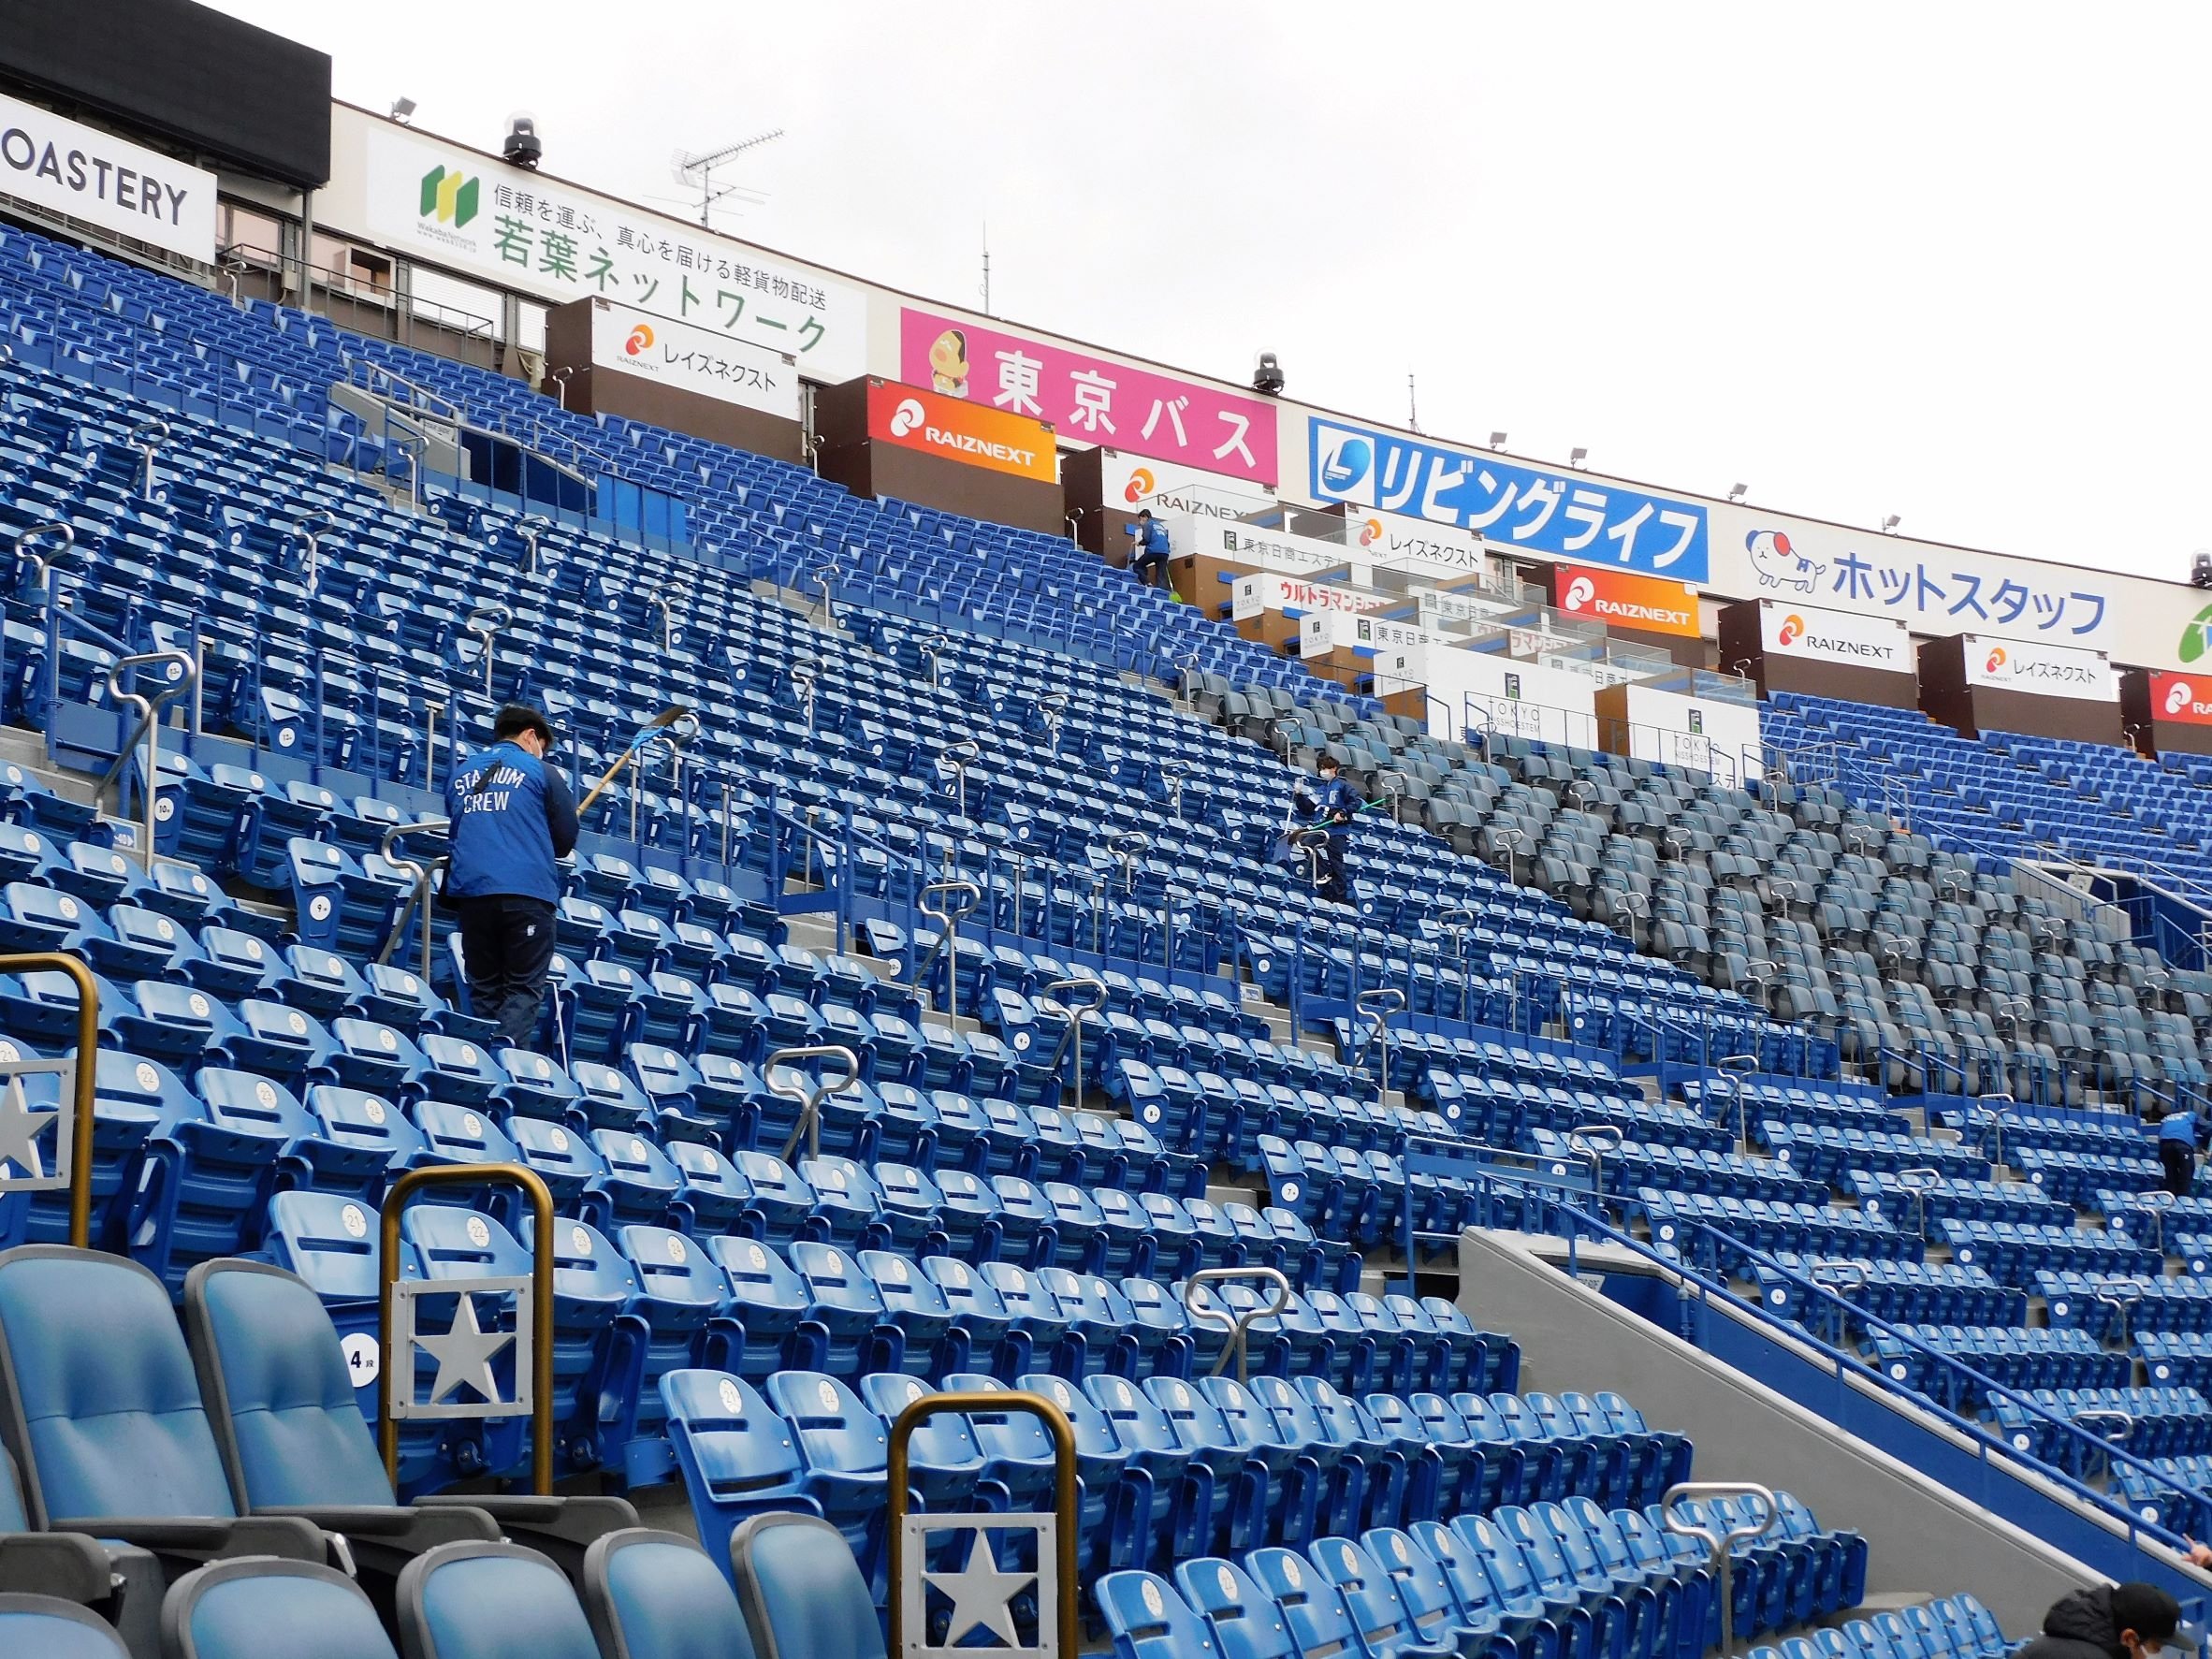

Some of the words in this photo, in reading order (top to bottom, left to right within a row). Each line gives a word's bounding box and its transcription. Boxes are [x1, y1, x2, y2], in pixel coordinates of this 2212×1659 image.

[2, 127, 188, 226] OASTERY
[494, 182, 826, 311] 信頼を運ぶ、真心を届ける軽貨物配送
[493, 212, 826, 354] 若葉ネットワーク
[617, 355, 660, 372] RAIZNEXT
[664, 342, 777, 392] レイズネクスト
[993, 349, 1258, 469] 東京バス
[924, 426, 1036, 467] RAIZNEXT
[1157, 493, 1249, 520] RAIZNEX
[1380, 446, 1700, 570] リビングライフ
[1244, 538, 1343, 569] 東京日商エステ
[1390, 533, 1478, 568] レイズネクスト
[1833, 552, 2105, 635] ホットスタッフ
[1594, 598, 1691, 627] RAIZNEXT
[1806, 634, 1894, 660] RAIZNEXT
[2014, 659, 2097, 684] レイズネクスト
[1488, 700, 1540, 721] TOKYO
[454, 765, 526, 797] STAIUM
[463, 791, 510, 814] CREW
[142, 1071, 154, 1084] 22
[347, 1215, 359, 1227] 21
[472, 1226, 485, 1237] 22
[724, 1390, 735, 1404] 21
[822, 1390, 835, 1403] 22
